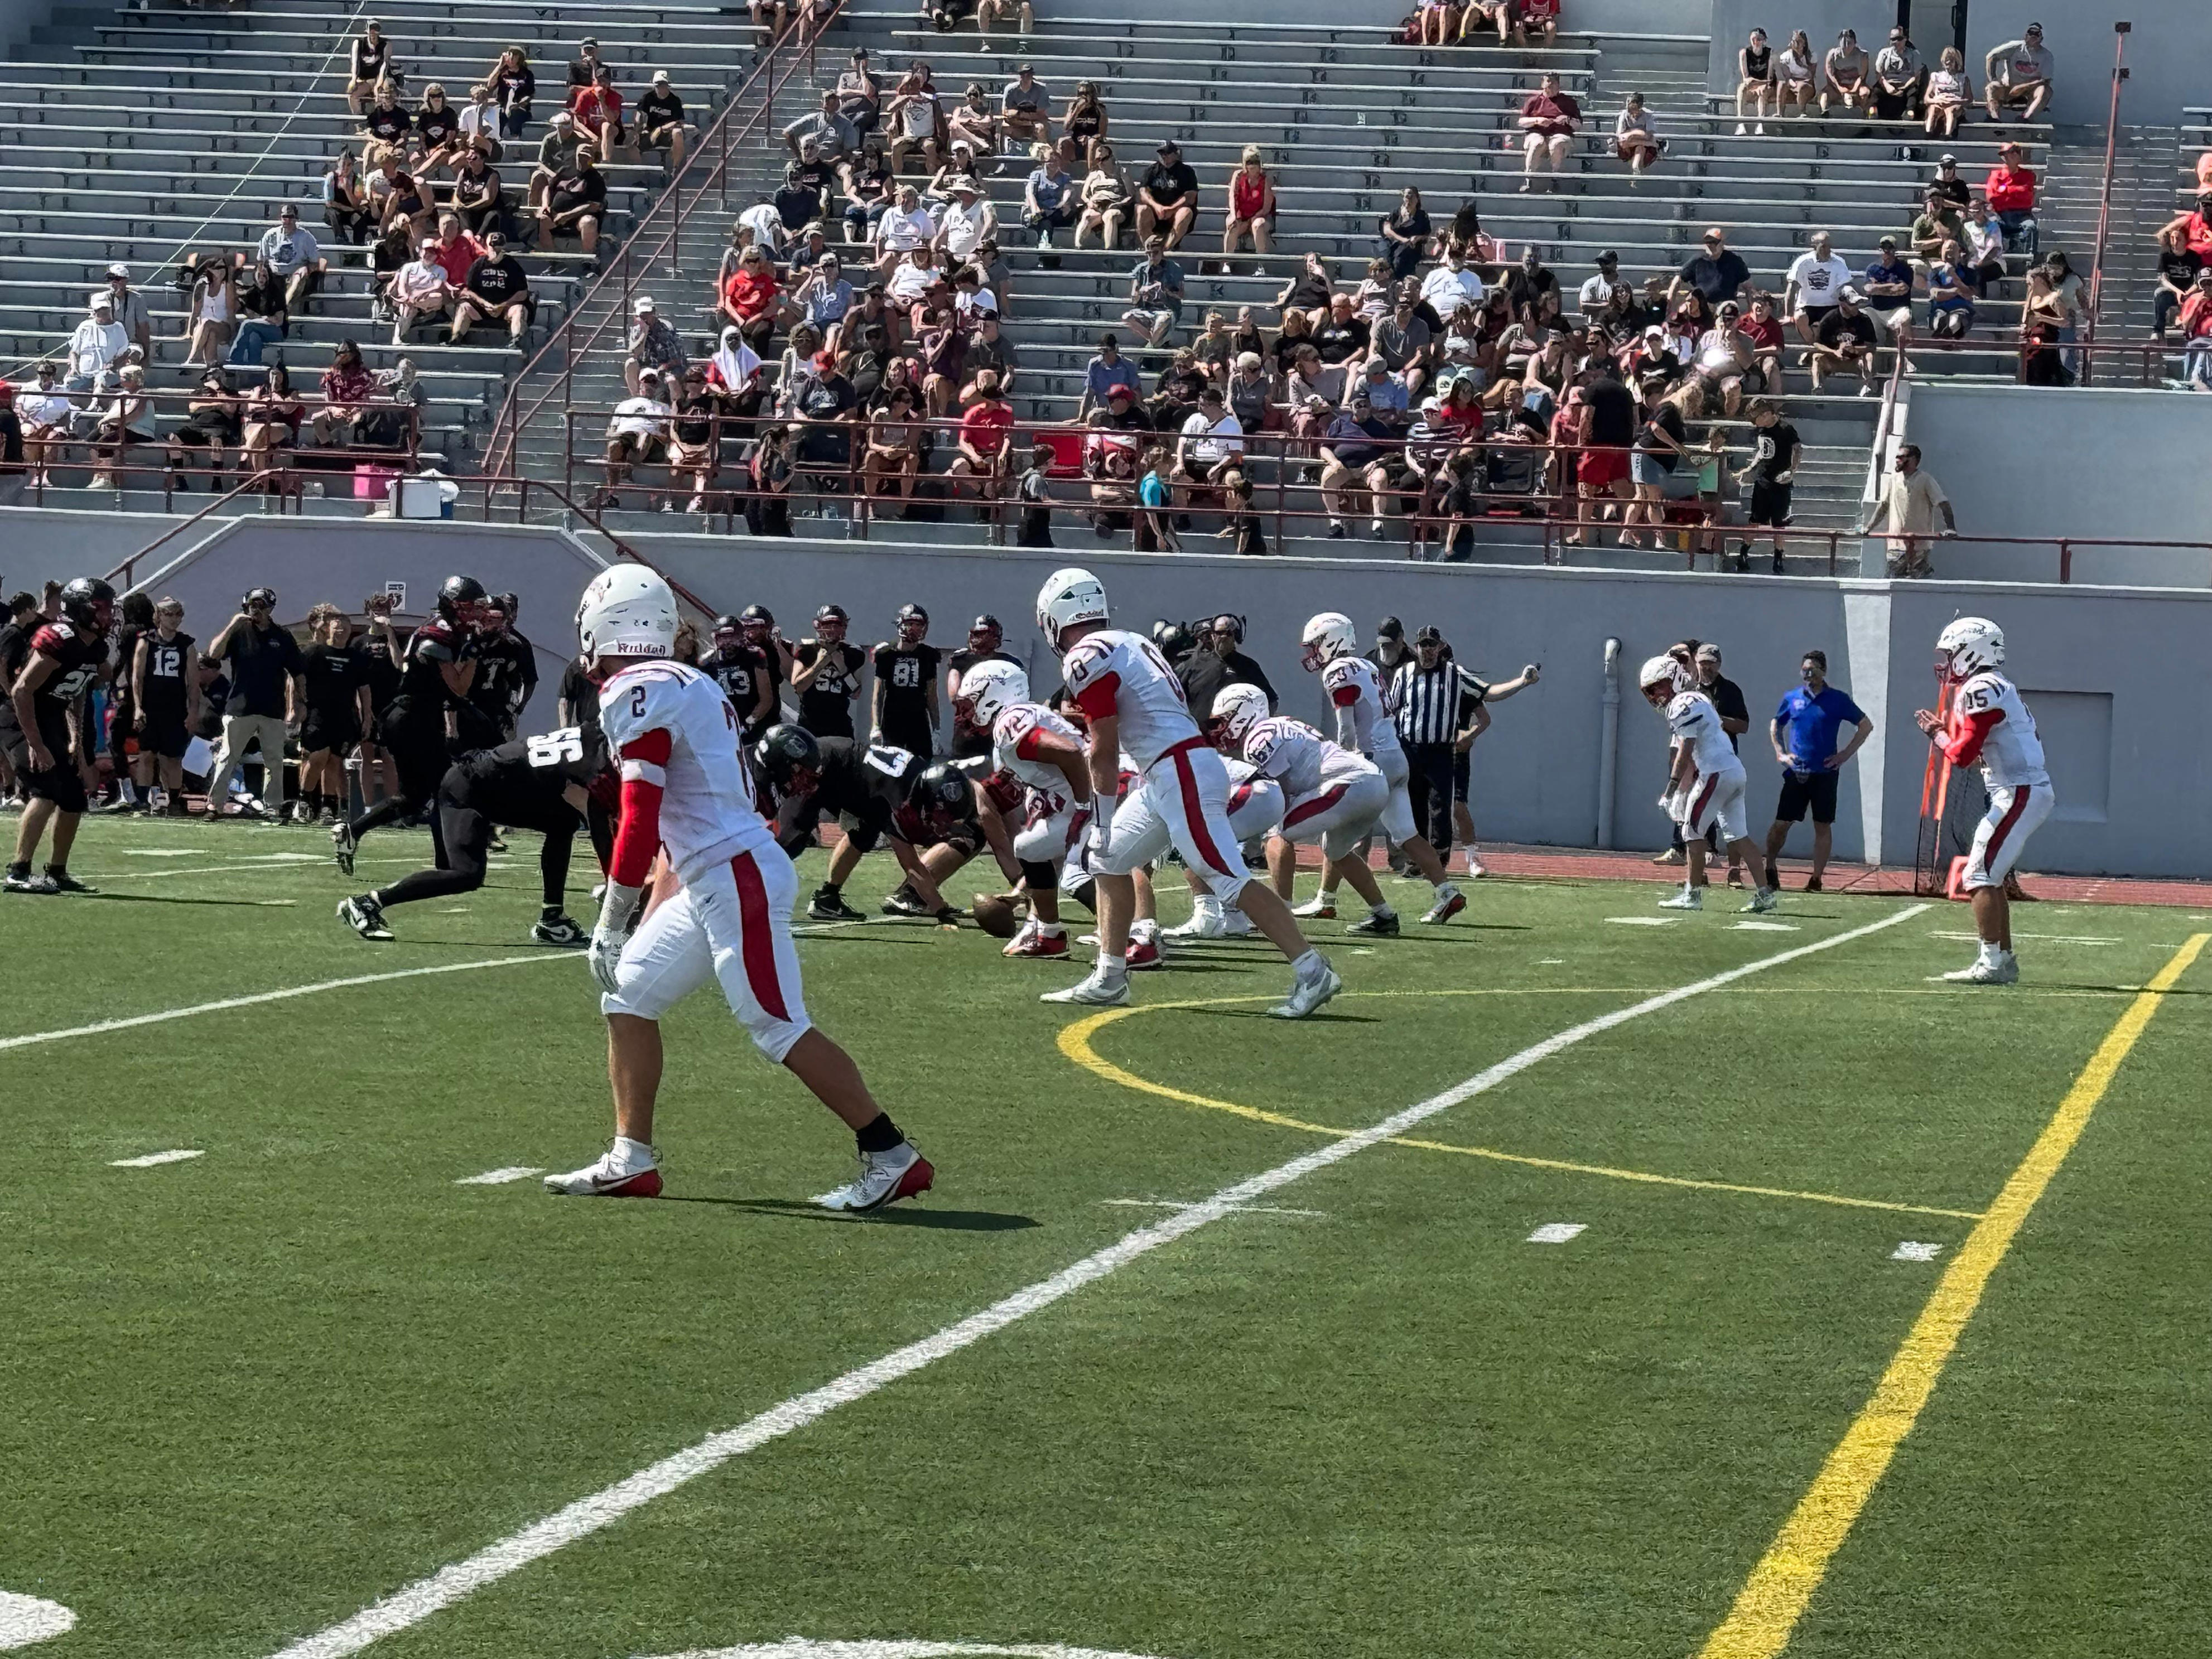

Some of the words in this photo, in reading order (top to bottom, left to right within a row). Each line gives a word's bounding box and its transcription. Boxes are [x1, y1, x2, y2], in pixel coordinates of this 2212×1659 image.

[153, 649, 180, 677] 12
[893, 658, 919, 687] 81
[631, 685, 646, 718] 2
[1965, 687, 1988, 710] 15
